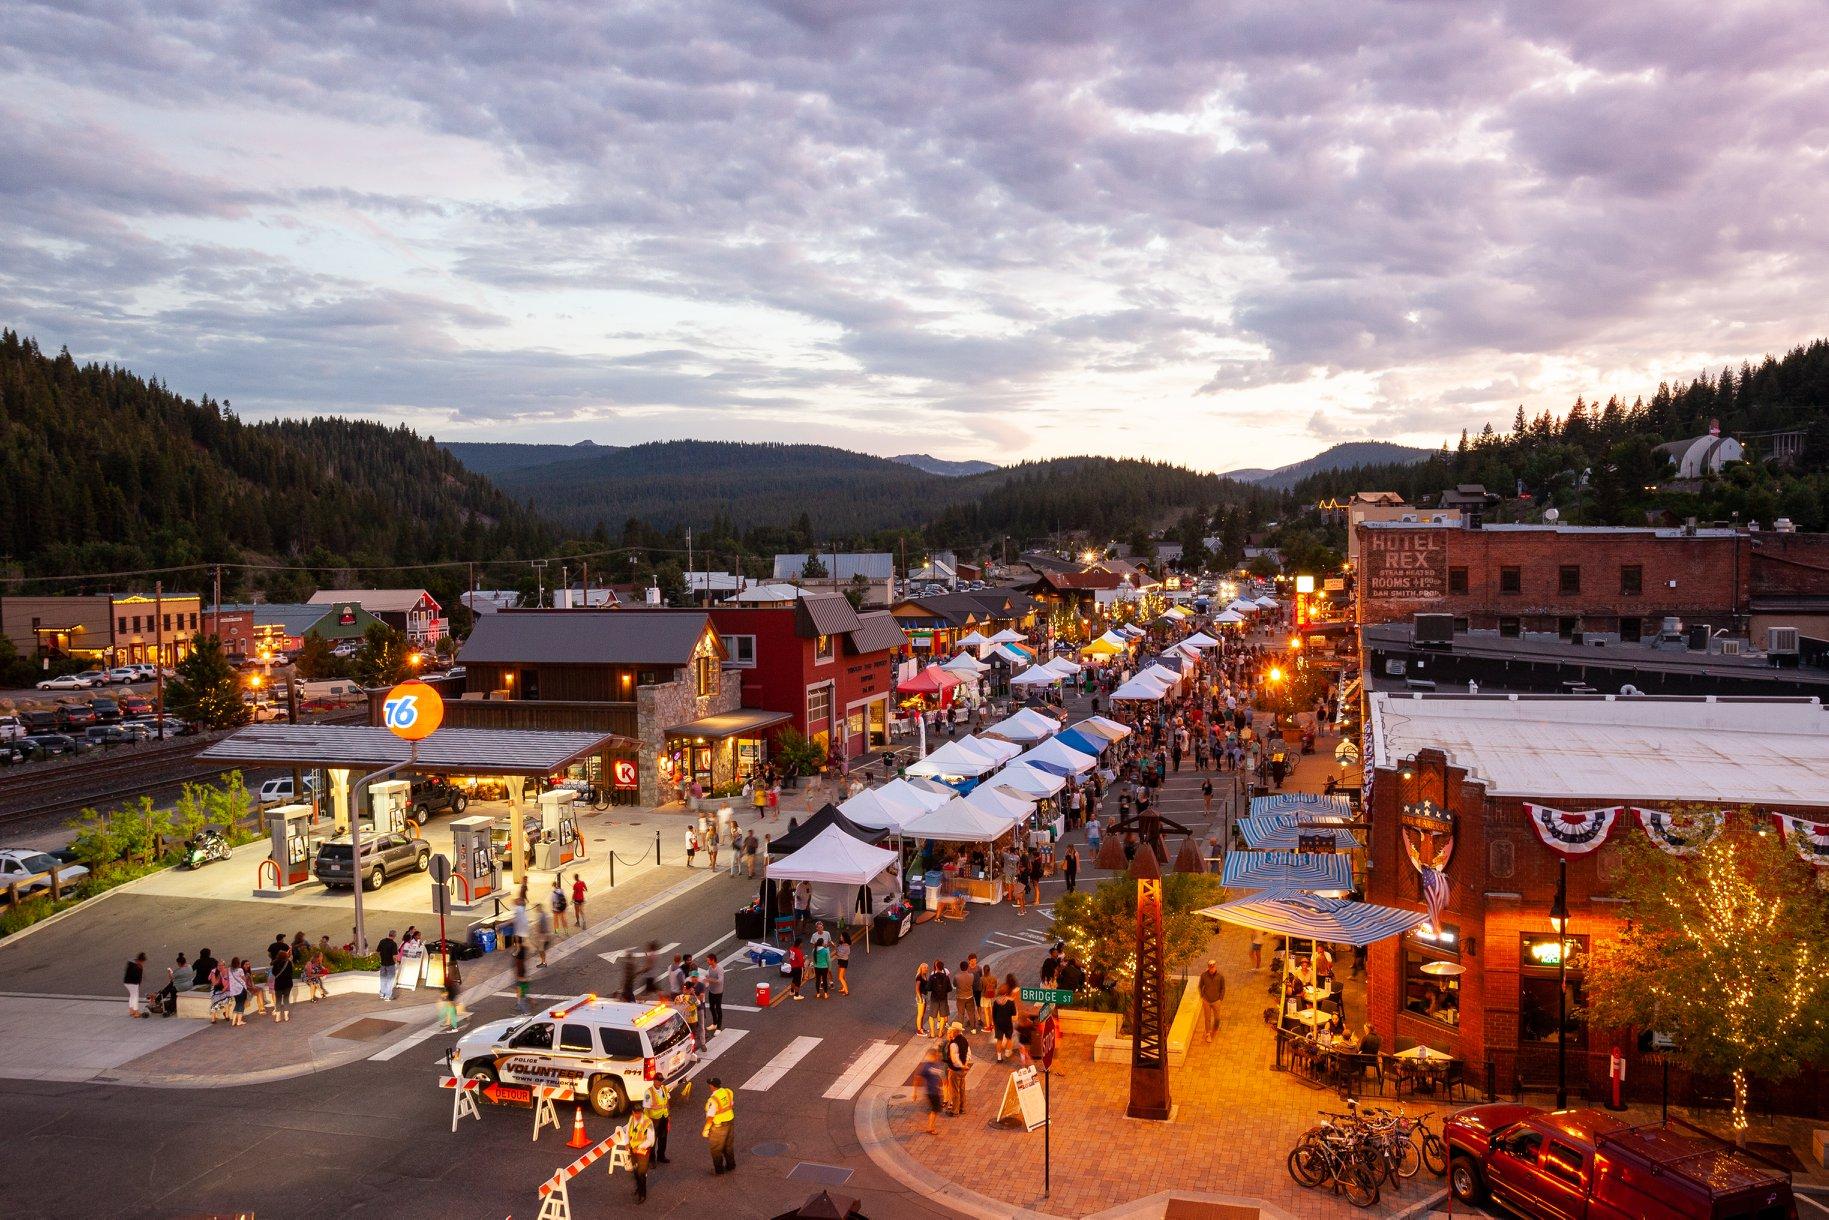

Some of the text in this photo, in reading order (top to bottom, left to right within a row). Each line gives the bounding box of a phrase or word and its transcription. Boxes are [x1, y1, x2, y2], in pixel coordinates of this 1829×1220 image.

[1373, 534, 1440, 551] HOTEL
[1385, 552, 1428, 568] REX
[1372, 577, 1410, 588] ROOMS
[384, 697, 417, 727] 76
[621, 767, 633, 781] K
[1022, 990, 1072, 1003] BRIDGE ST
[1042, 1028, 1056, 1057] STOP
[506, 1063, 585, 1080] VOLUNTEER
[512, 1075, 533, 1083] TOWN
[546, 1078, 579, 1087] TRUCKEE
[495, 1088, 528, 1100] DETOUR
